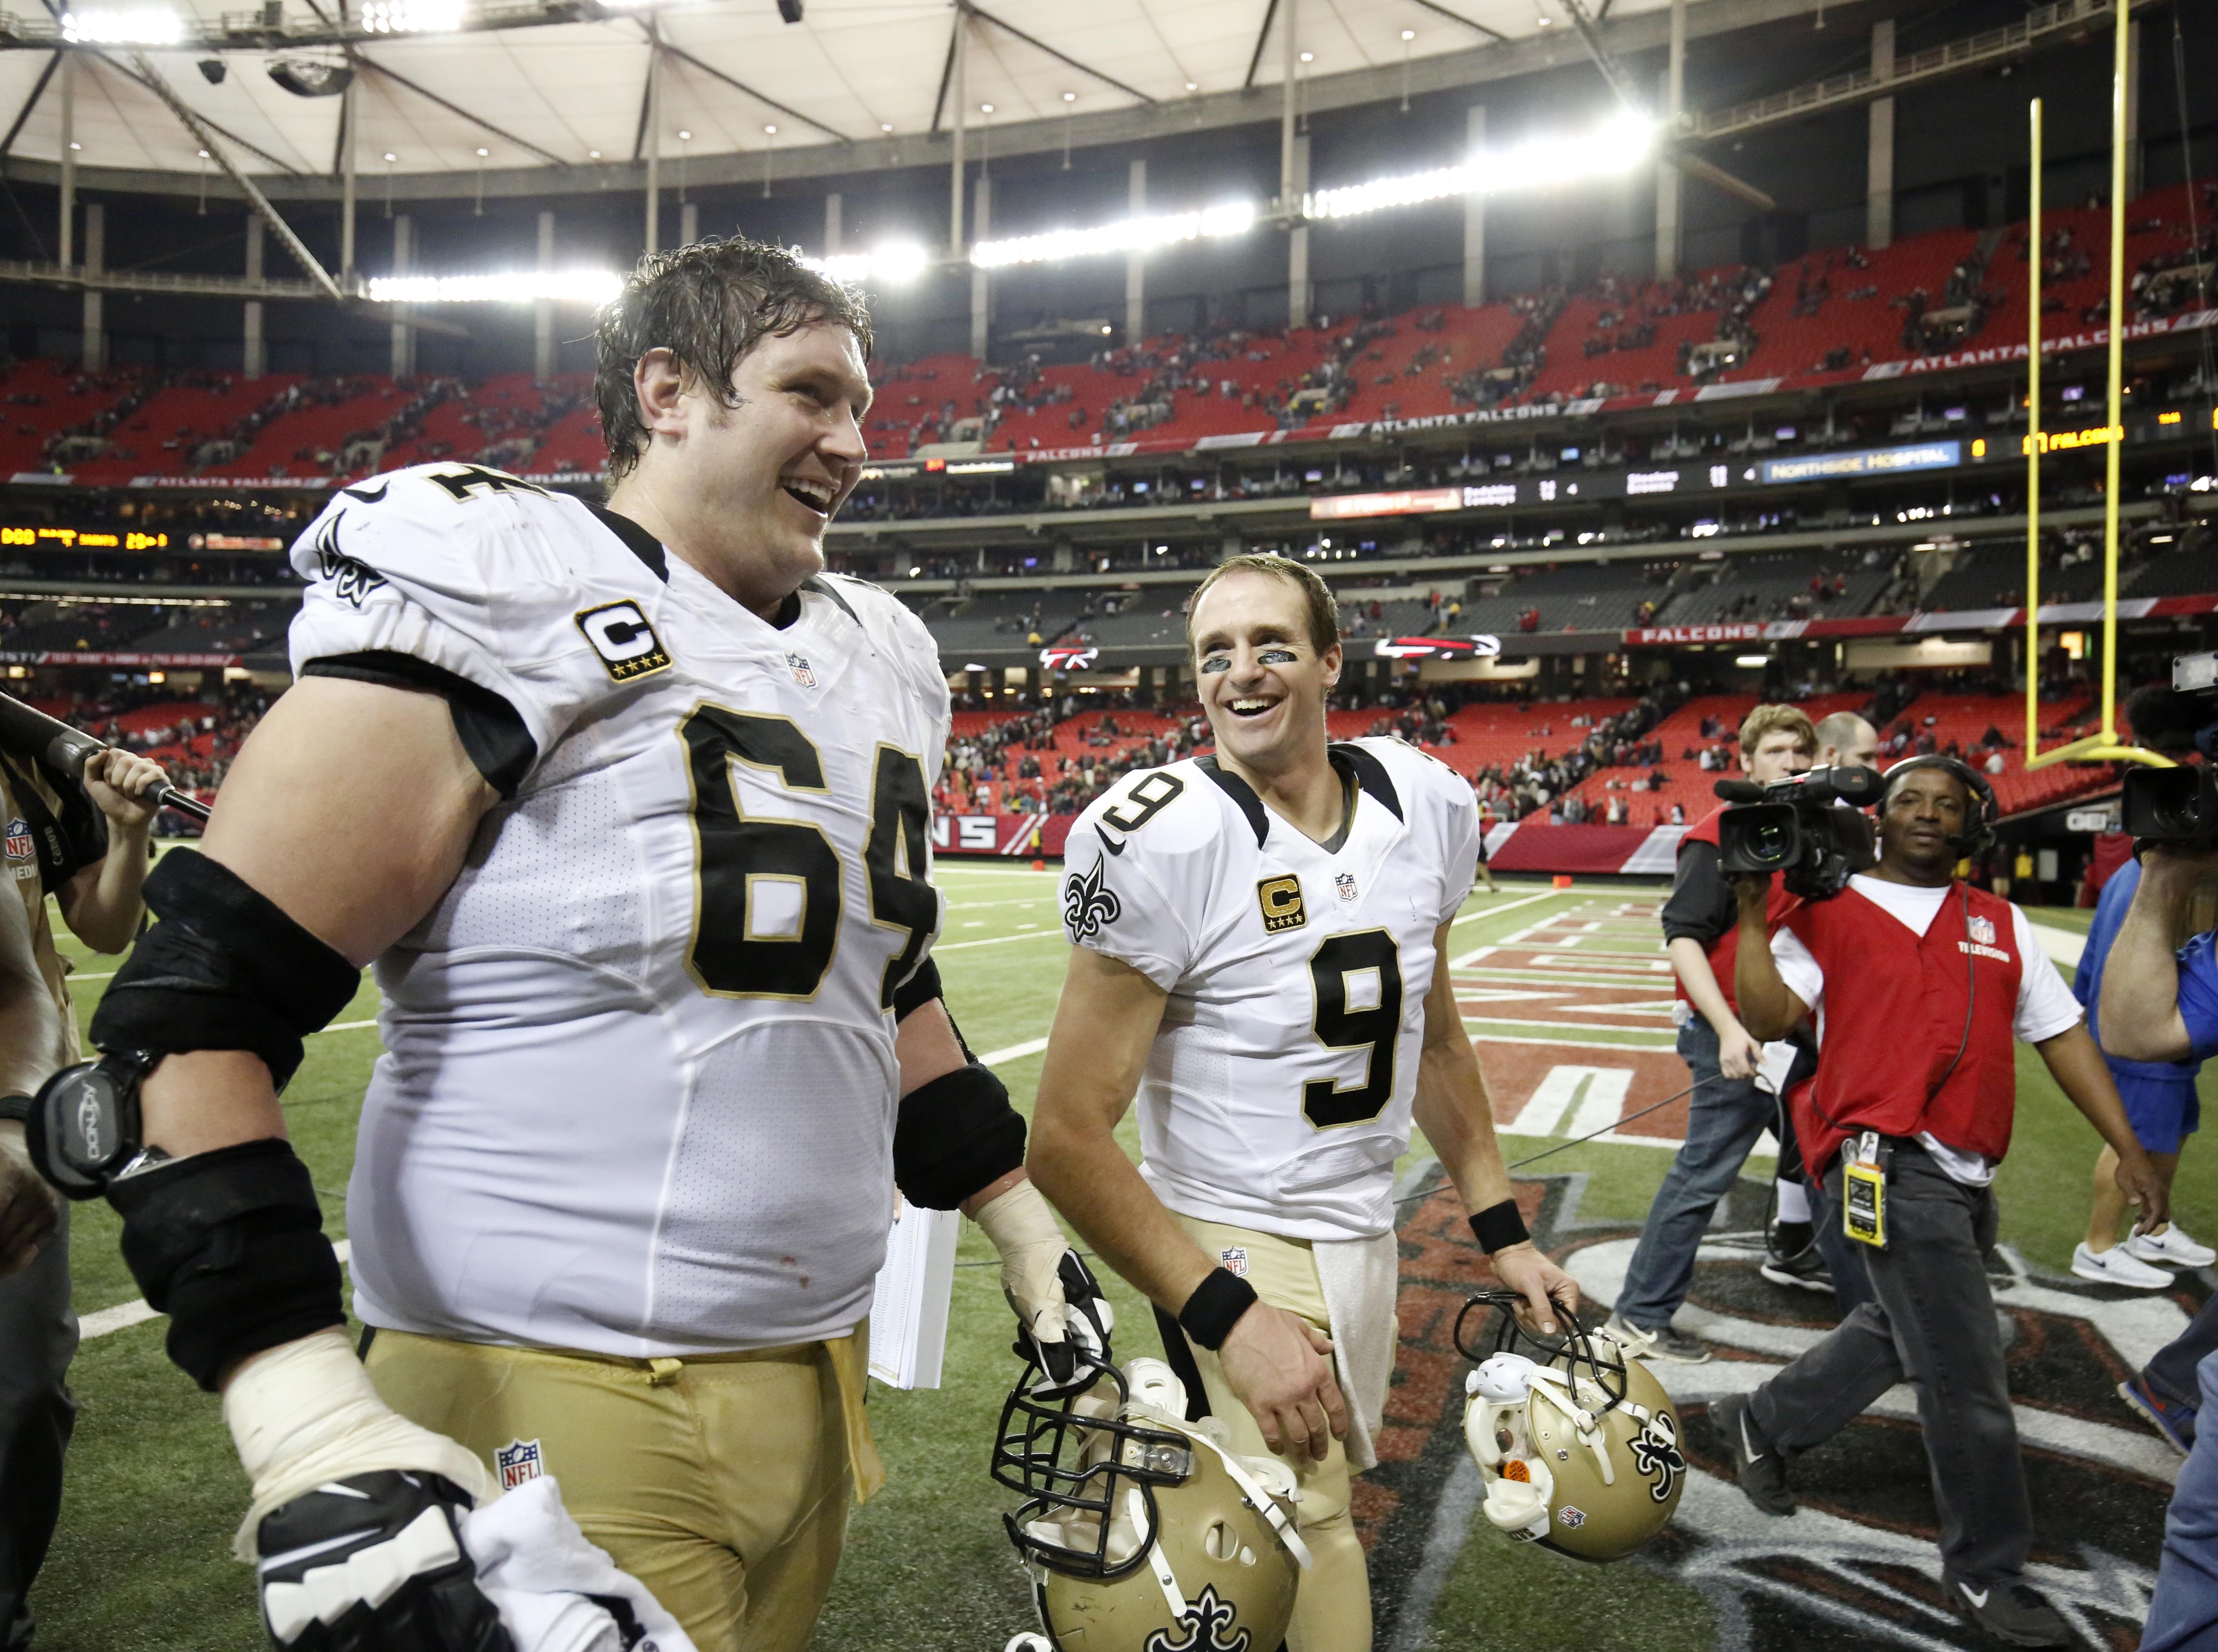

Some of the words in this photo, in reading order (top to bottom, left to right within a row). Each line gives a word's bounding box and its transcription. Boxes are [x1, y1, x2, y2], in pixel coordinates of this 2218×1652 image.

[1910, 343, 2029, 373] ATLANTA
[1370, 414, 1459, 434] ATLANTA
[1464, 404, 1558, 424] FALCONS
[1026, 447, 1103, 462] FALCONS
[1866, 448, 1950, 469] HOSPITAL
[158, 476, 229, 487] ATLANTA
[233, 476, 302, 488] FALCONS
[583, 606, 655, 661] C
[1641, 624, 1758, 644] FALCONS
[791, 668, 814, 684] NFL
[1100, 771, 1187, 835] 9
[6, 836, 33, 856] NFL
[45, 825, 64, 866] Canon
[674, 699, 939, 1016] 64
[1261, 878, 1301, 918] C
[1339, 884, 1356, 898] NFL
[1300, 926, 1406, 1134] 9
[1225, 1260, 1245, 1274] NFL
[505, 1462, 538, 1487] NFL
[1561, 1509, 1577, 1522] NFL
